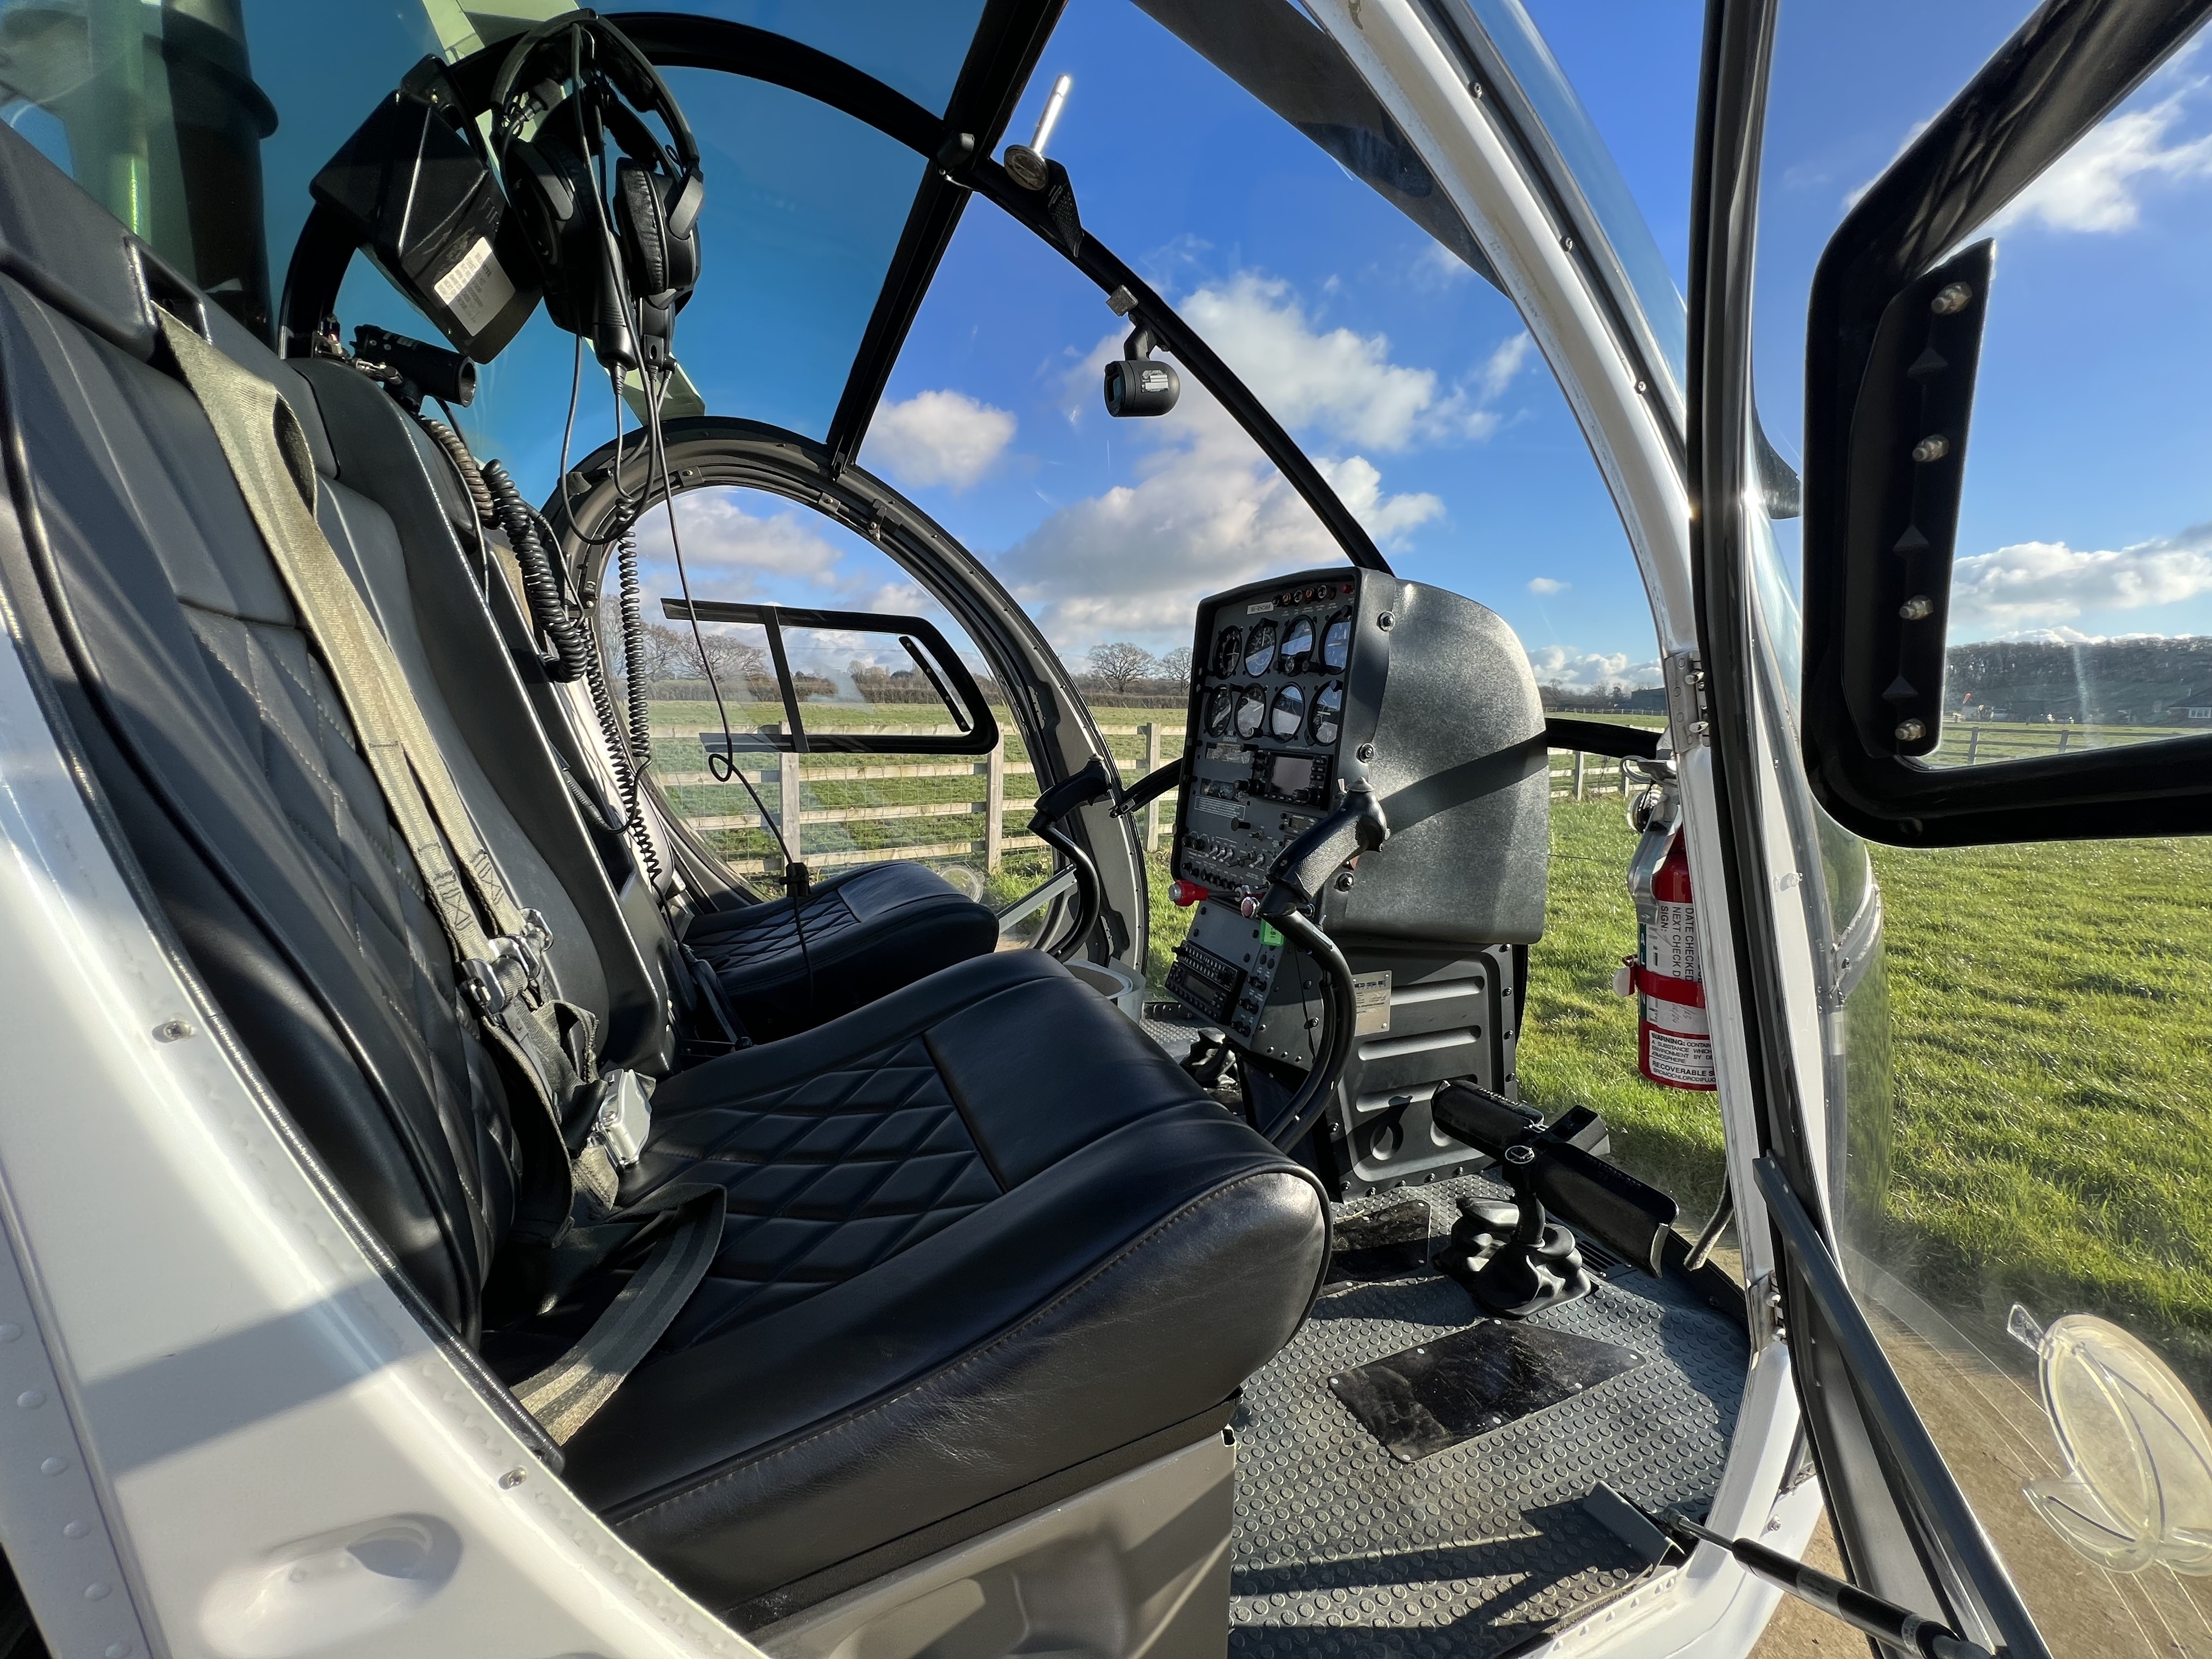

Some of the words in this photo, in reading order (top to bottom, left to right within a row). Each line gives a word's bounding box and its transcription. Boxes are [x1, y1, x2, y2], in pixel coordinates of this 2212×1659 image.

[1672, 906, 1681, 932] NEXT
[1685, 908, 1694, 932] DATE
[1672, 935, 1681, 967] CHECK
[1651, 1033, 1685, 1046] WARNING:
[1652, 1045, 1689, 1058] ENVIRONMENT
[1657, 1042, 1689, 1052] SUBSTANCE
[1652, 1051, 1686, 1063] ATMOSPHERE
[1652, 1060, 1706, 1076] RECOVERABLE
